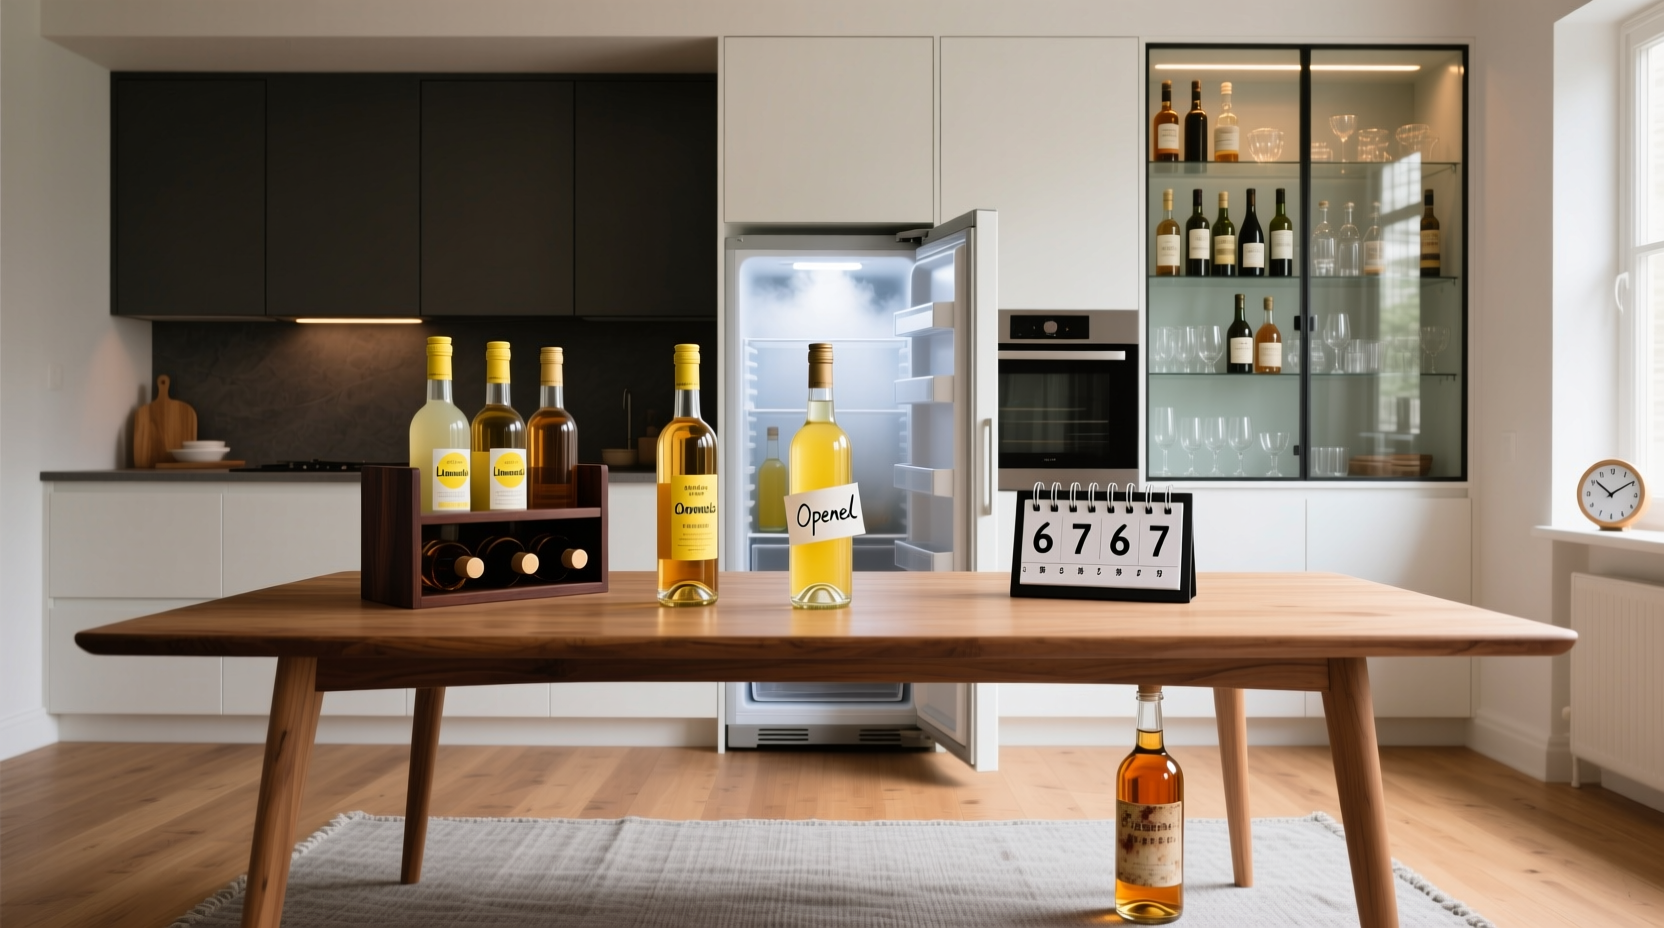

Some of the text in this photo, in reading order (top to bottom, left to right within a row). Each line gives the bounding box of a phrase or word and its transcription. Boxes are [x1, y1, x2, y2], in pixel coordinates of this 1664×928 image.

[1033, 521, 1170, 557] 6 7 6 7
